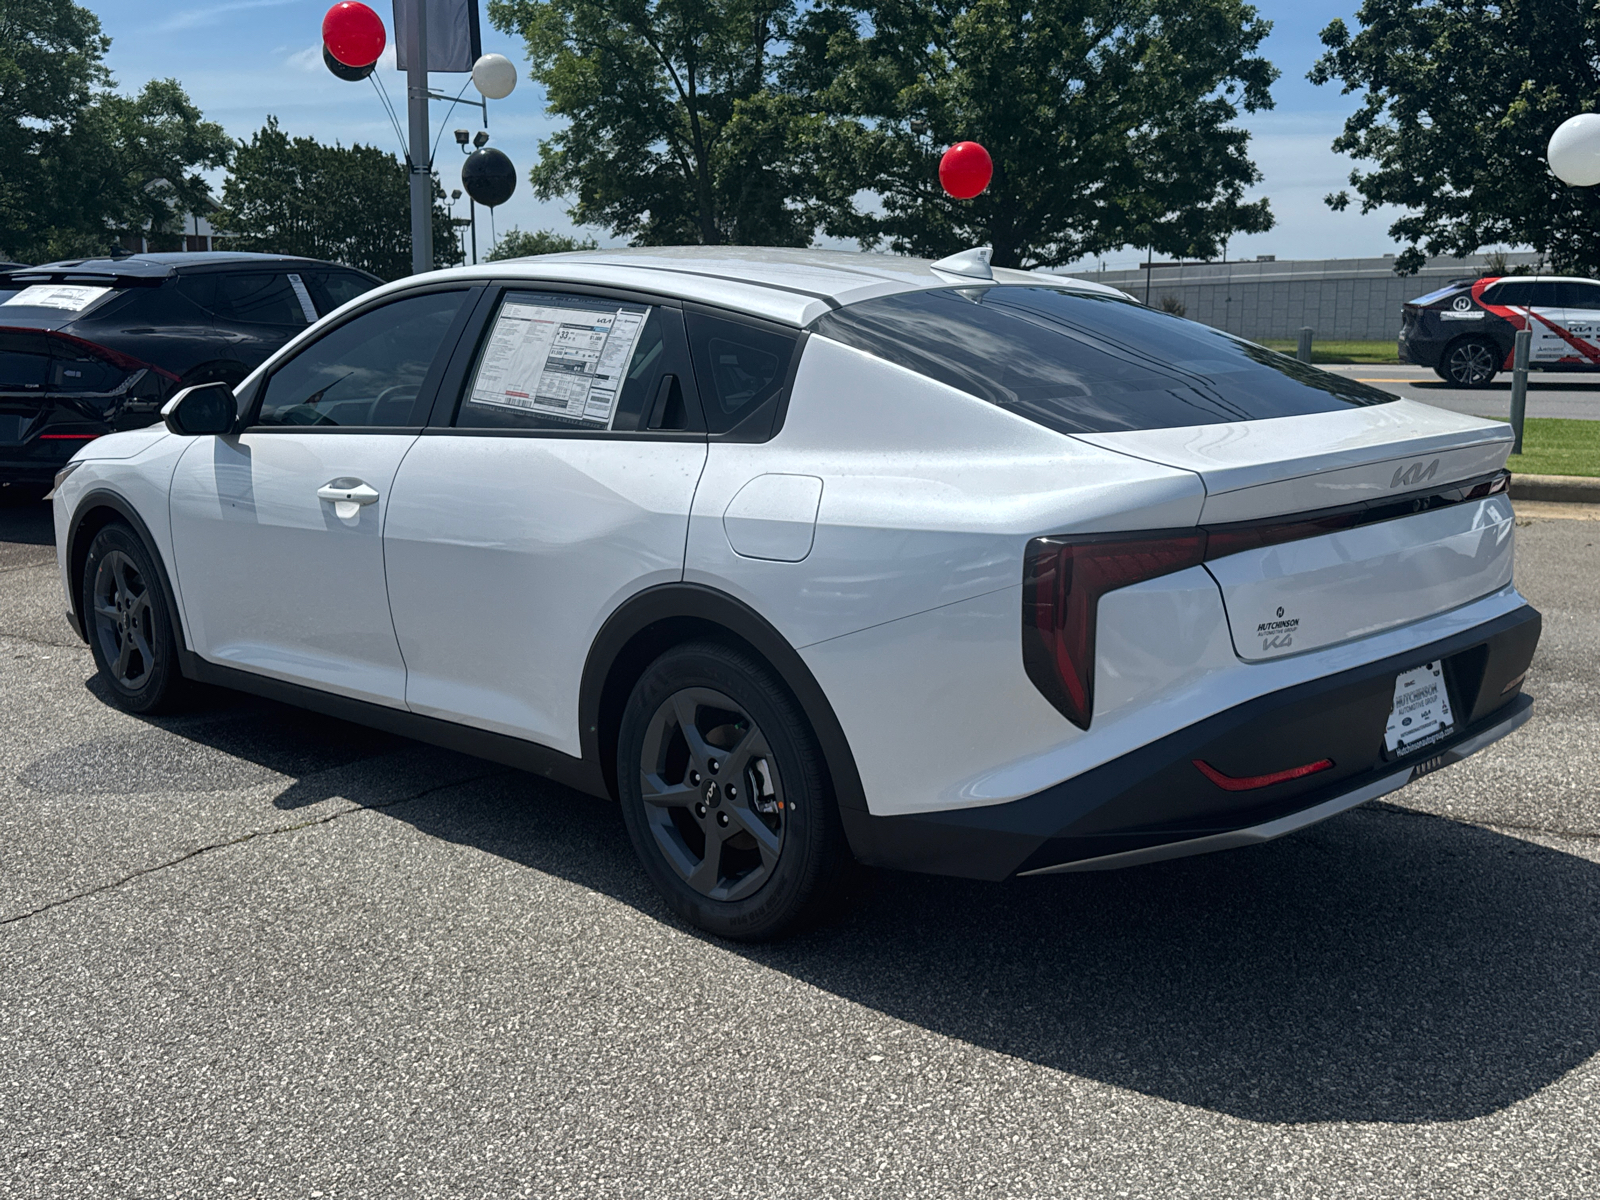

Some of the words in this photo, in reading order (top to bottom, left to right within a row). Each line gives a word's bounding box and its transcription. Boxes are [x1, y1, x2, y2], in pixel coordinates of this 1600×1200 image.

[1390, 459, 1440, 488] KIA
[1257, 618, 1300, 632] HUTCHINSON
[1263, 633, 1292, 651] K4
[1395, 683, 1438, 709] HUTCHINSON
[1398, 700, 1424, 716] AUTOMOTIVE
[1425, 695, 1438, 706] GROUP
